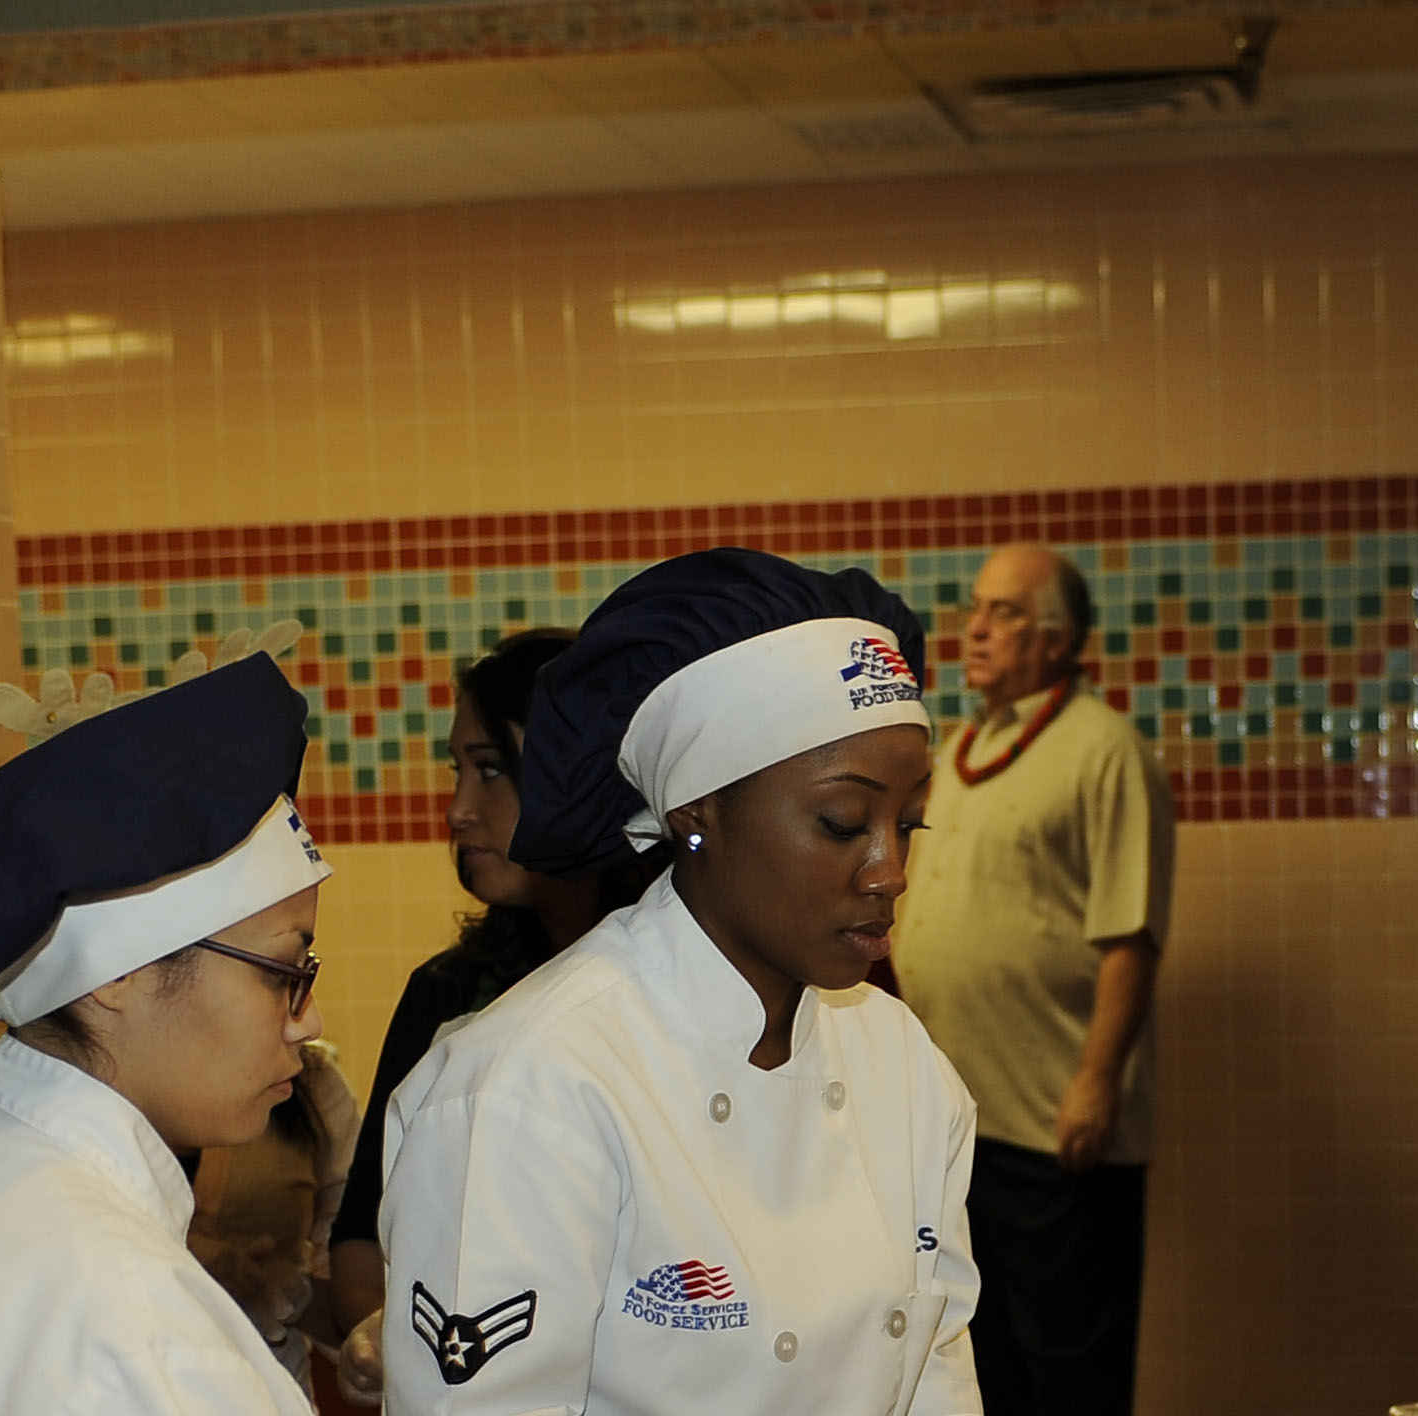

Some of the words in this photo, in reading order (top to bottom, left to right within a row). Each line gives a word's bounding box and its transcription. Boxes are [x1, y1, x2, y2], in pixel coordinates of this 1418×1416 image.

[850, 691, 894, 711] FOOD
[622, 1299, 668, 1327] FOOD
[671, 1312, 750, 1331] SERVICE
